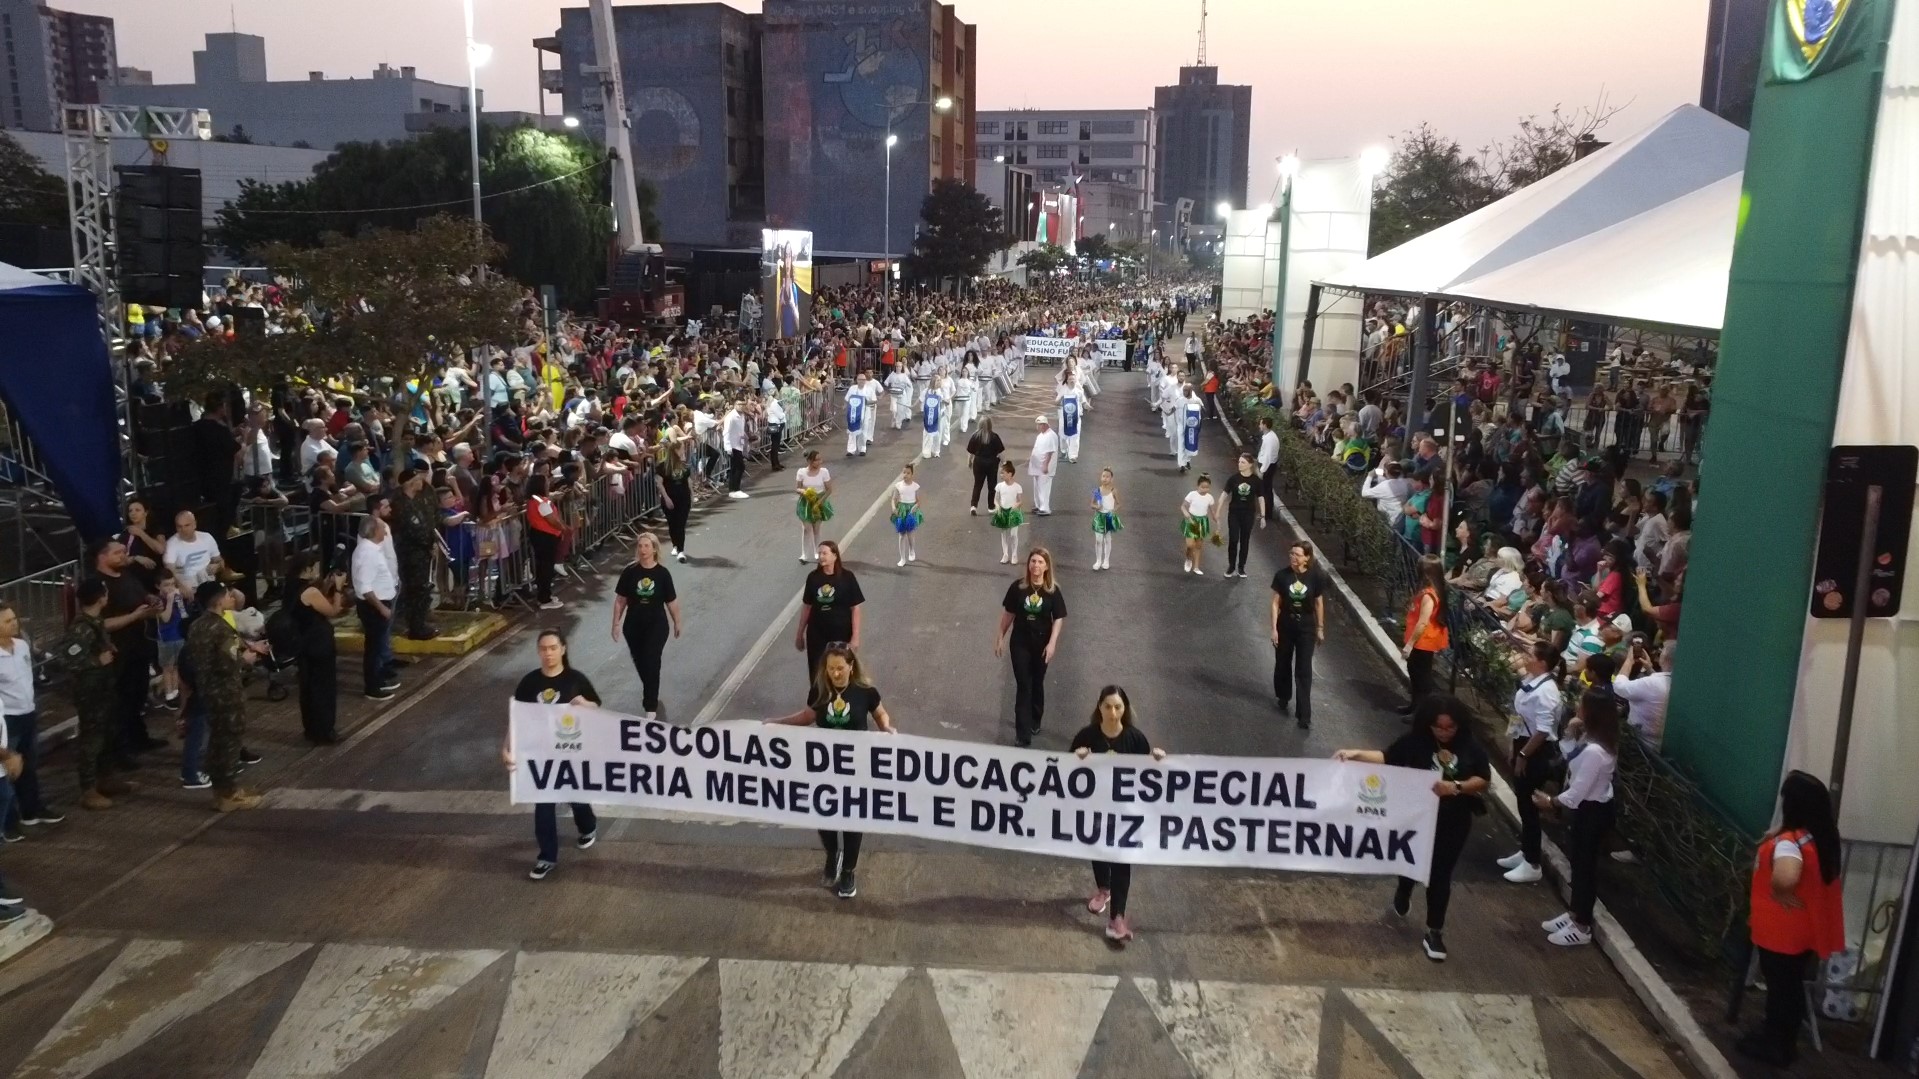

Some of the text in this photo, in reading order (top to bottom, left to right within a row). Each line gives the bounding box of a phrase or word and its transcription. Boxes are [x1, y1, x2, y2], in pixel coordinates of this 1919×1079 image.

[1026, 339, 1071, 348] EDUCAÇÃO
[1025, 347, 1056, 355] ENSINO
[554, 742, 582, 751] APAE
[620, 719, 1317, 810] ESCOLAS DE EDUCAÇÃO ESPECIAL
[527, 759, 1417, 866] VALERIA MENEGHEL E DR. LUIZ PASTERNAK
[1356, 805, 1387, 817] APAE
